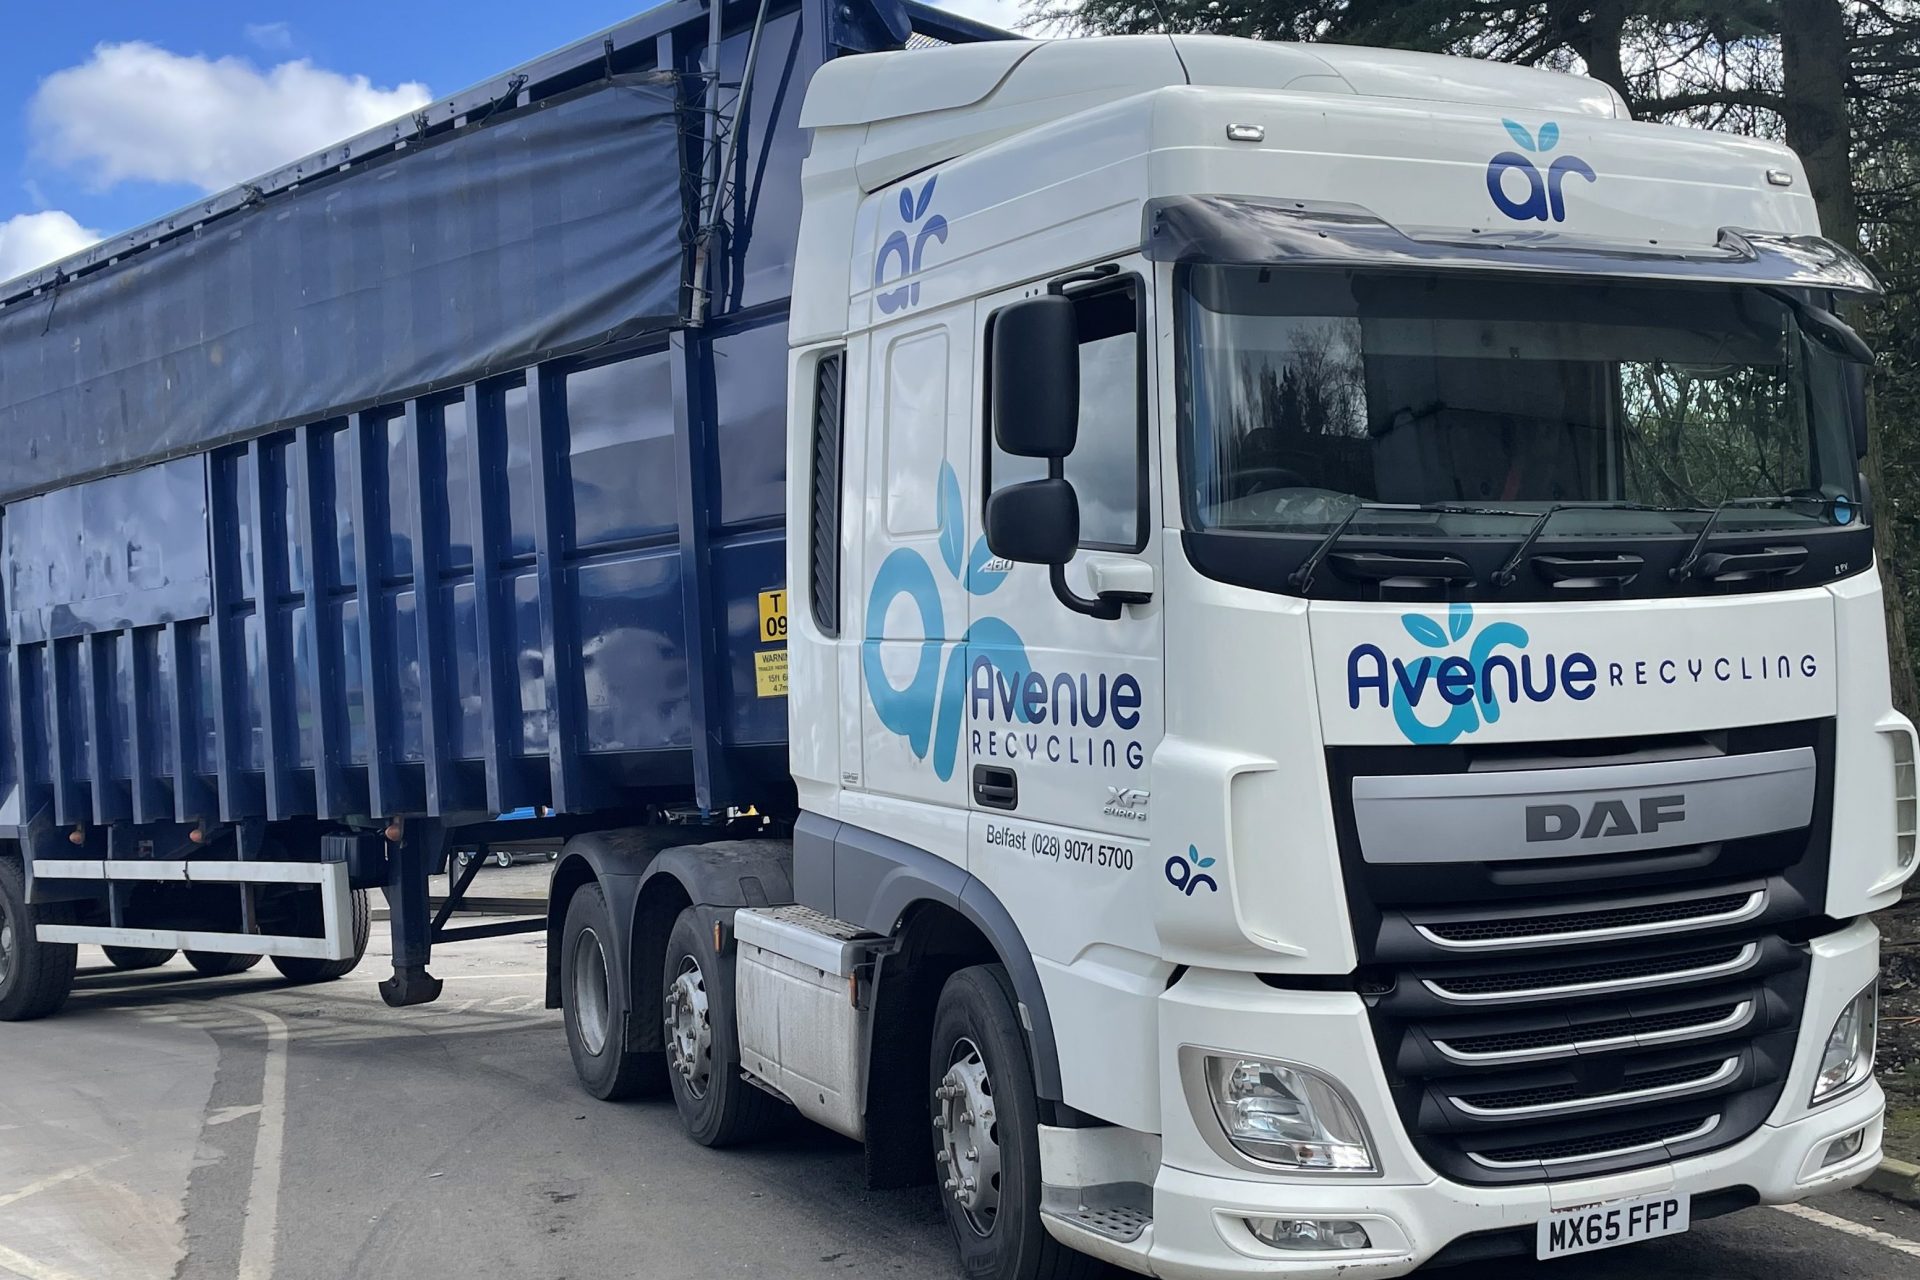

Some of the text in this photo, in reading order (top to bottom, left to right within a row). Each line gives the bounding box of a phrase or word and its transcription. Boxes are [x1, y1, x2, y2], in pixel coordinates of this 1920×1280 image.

[770, 594, 781, 613] T
[971, 654, 1142, 730] Avenue
[1347, 644, 1817, 710] Avenue RECYCLING
[972, 730, 1144, 770] RECYCLING
[1104, 786, 1151, 808] XF
[1525, 794, 1685, 843] DAF
[986, 824, 1133, 870] Belfast (028) 9071 5700
[1550, 1199, 1678, 1252] MX65 FFP
